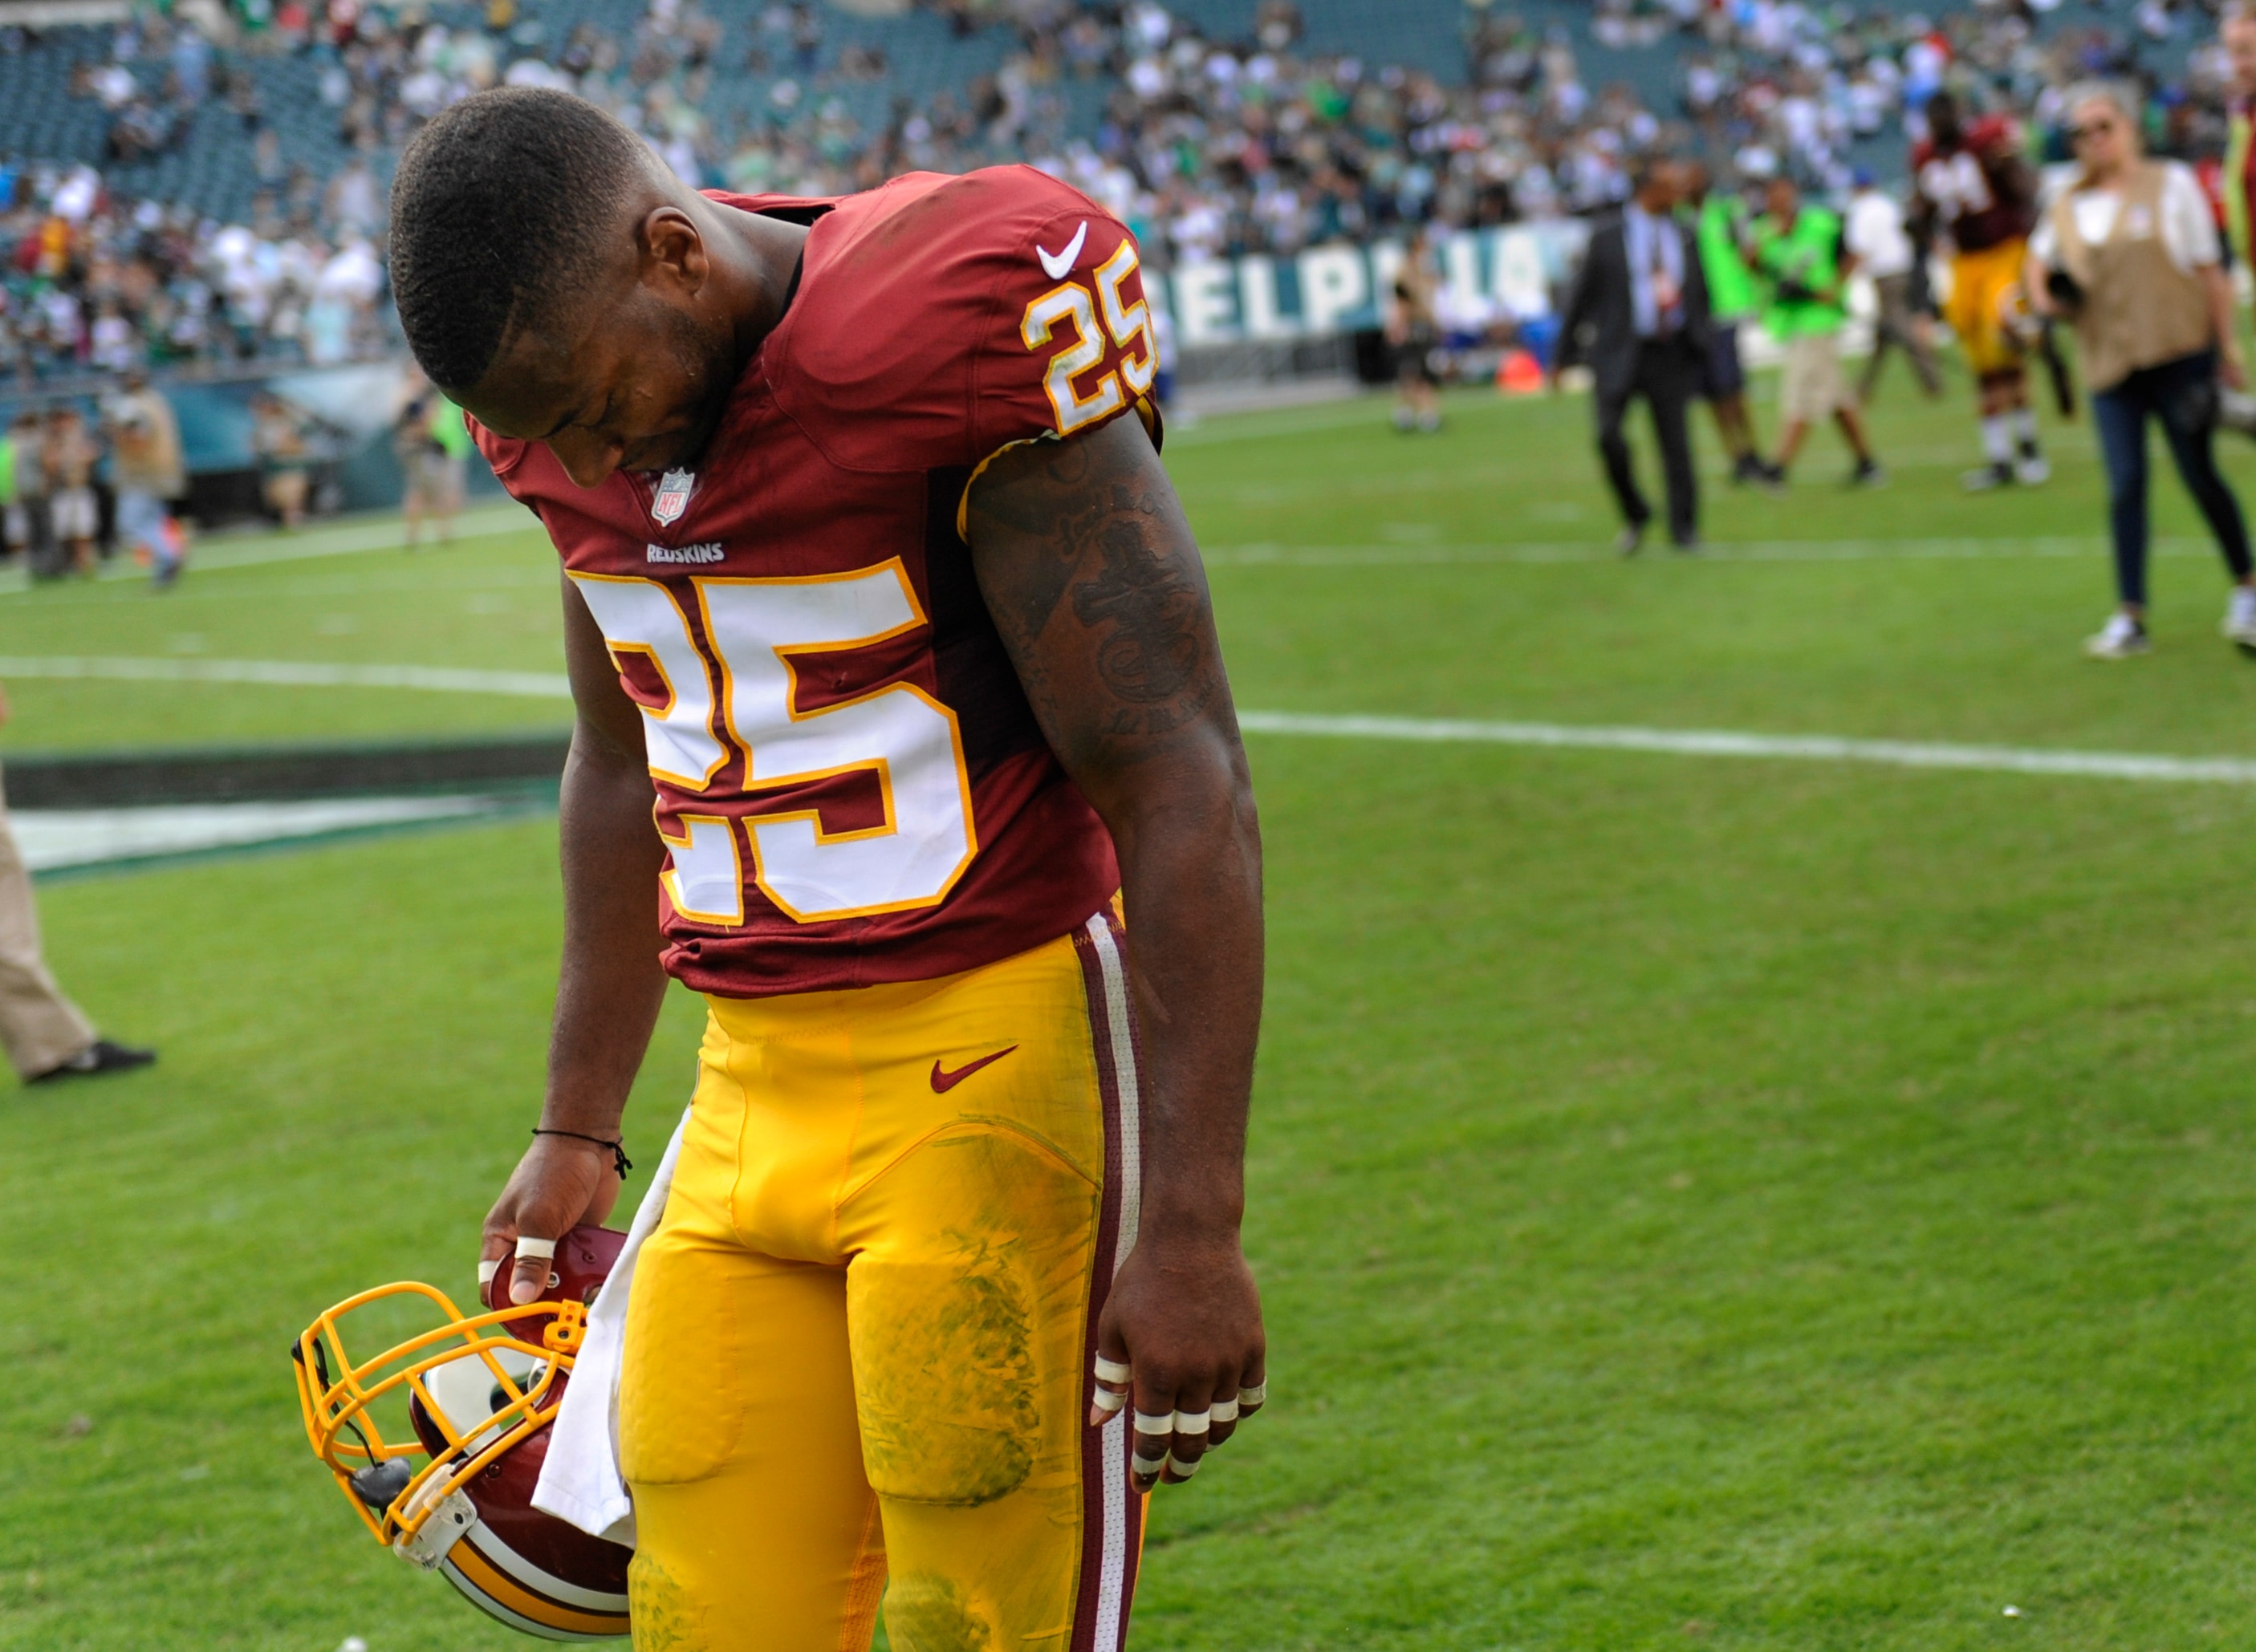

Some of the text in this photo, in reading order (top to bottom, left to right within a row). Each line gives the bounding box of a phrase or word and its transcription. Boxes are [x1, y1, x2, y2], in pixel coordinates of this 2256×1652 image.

[1019, 238, 1160, 437] 25
[647, 542, 725, 563] REDSKINS
[658, 492, 683, 516] NFL
[565, 555, 978, 927] 25
